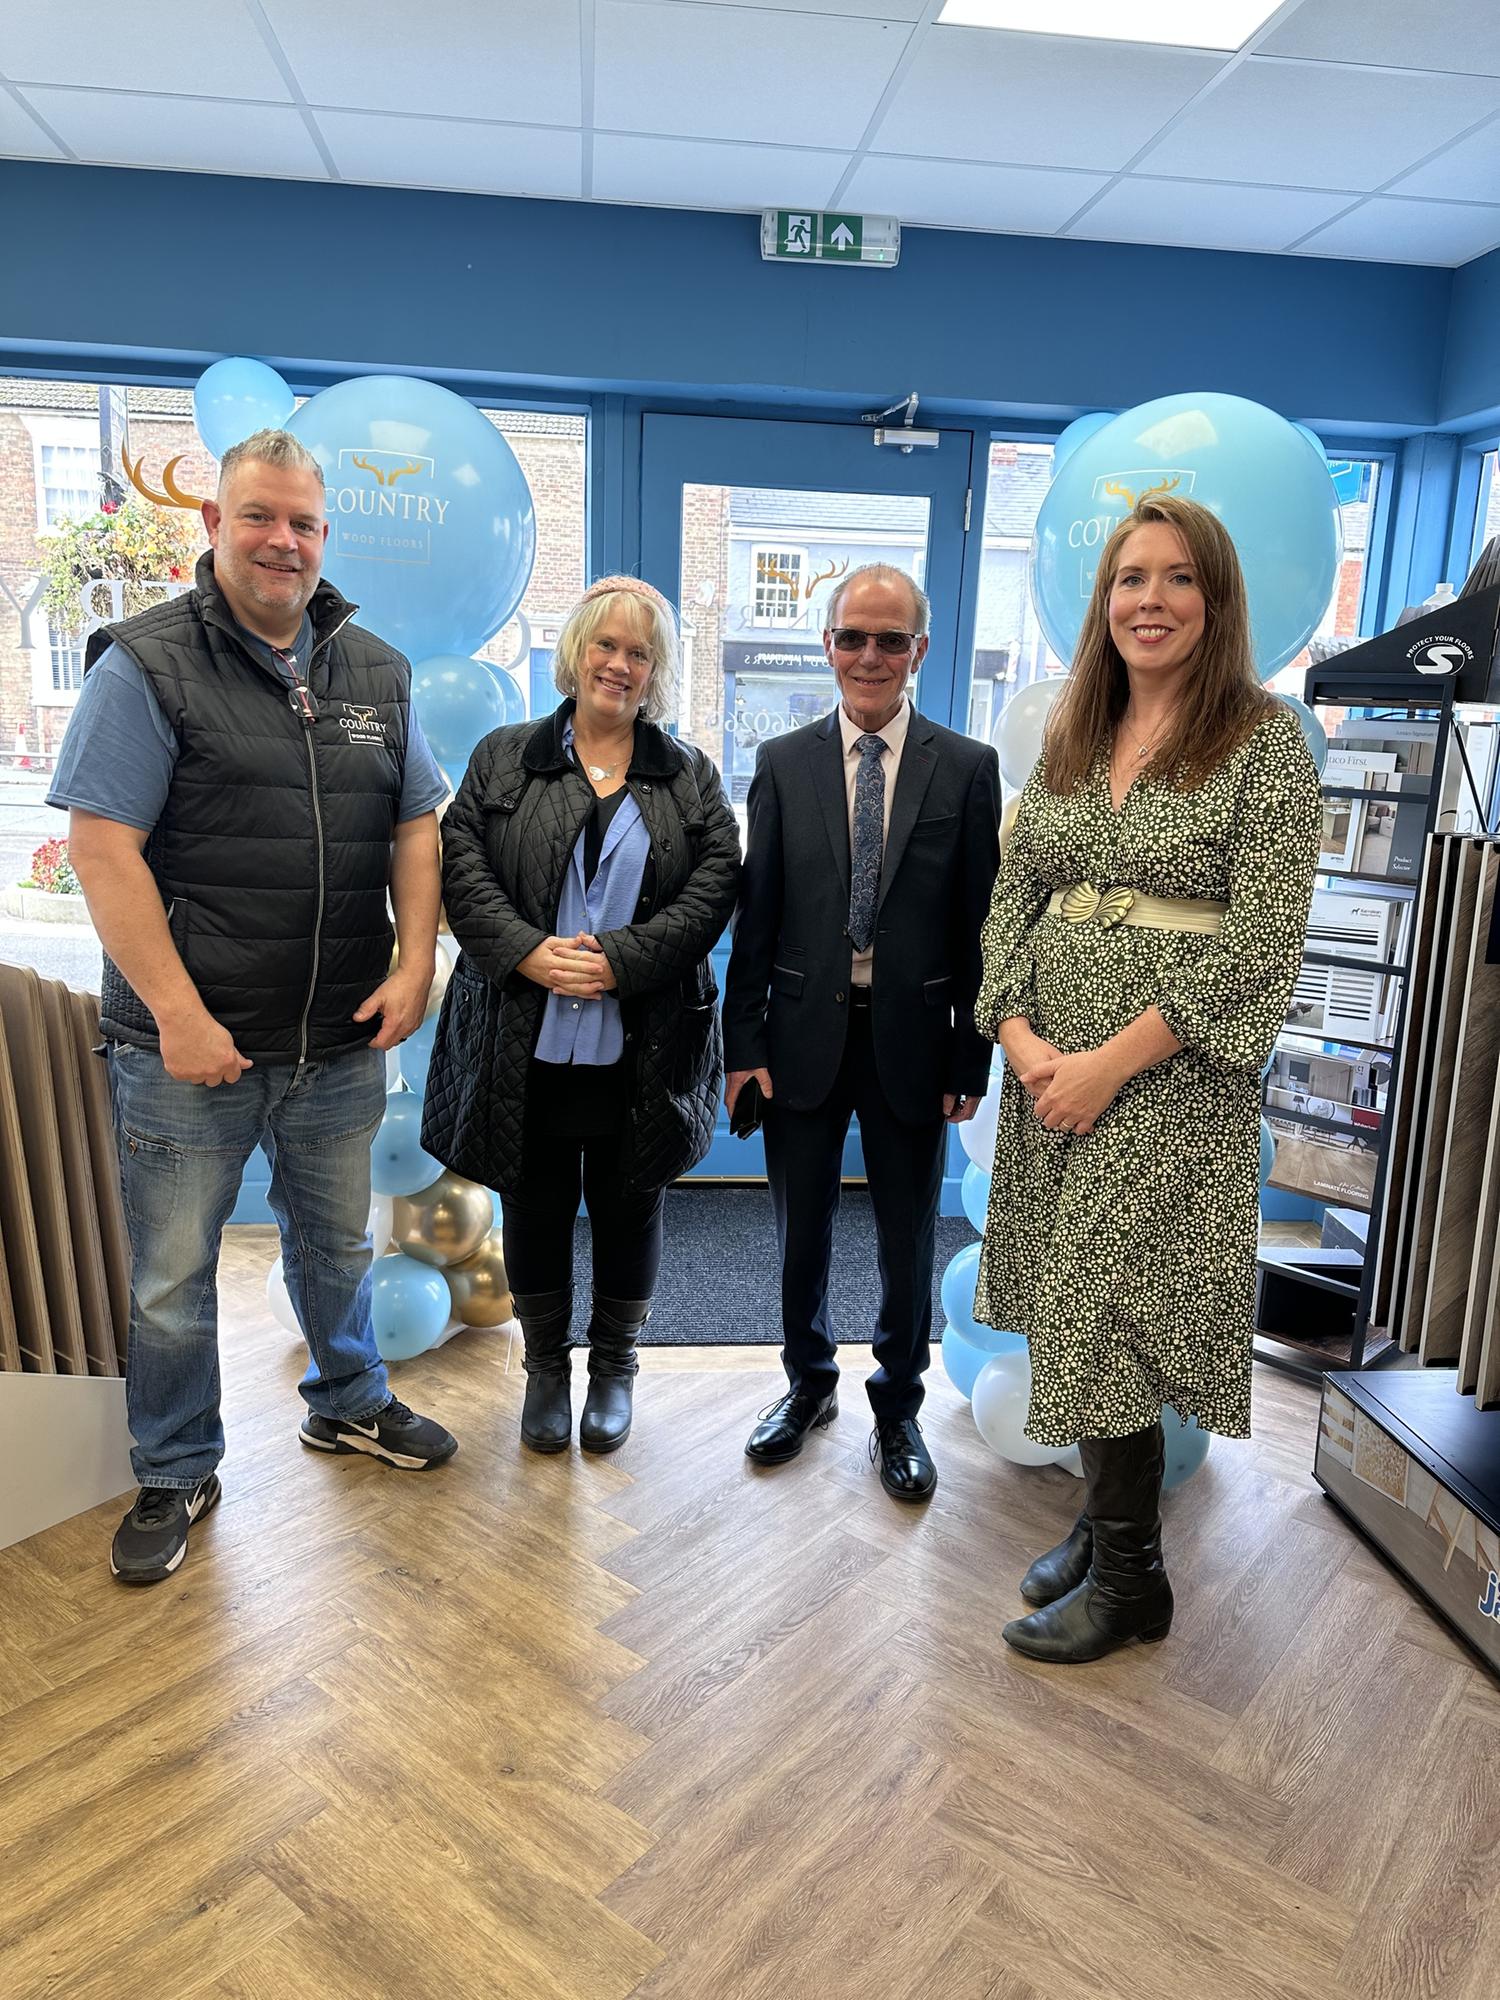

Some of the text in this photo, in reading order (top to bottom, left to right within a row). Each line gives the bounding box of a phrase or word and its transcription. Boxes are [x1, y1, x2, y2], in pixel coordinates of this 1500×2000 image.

[324, 487, 450, 525] COUNTRY
[342, 532, 424, 549] WOOD FLOORS
[1406, 635, 1474, 660] PROTECT YOUR FLOORS
[339, 717, 386, 733] COUNTRY
[1313, 1180, 1369, 1200] LAMINATE FLOORING
